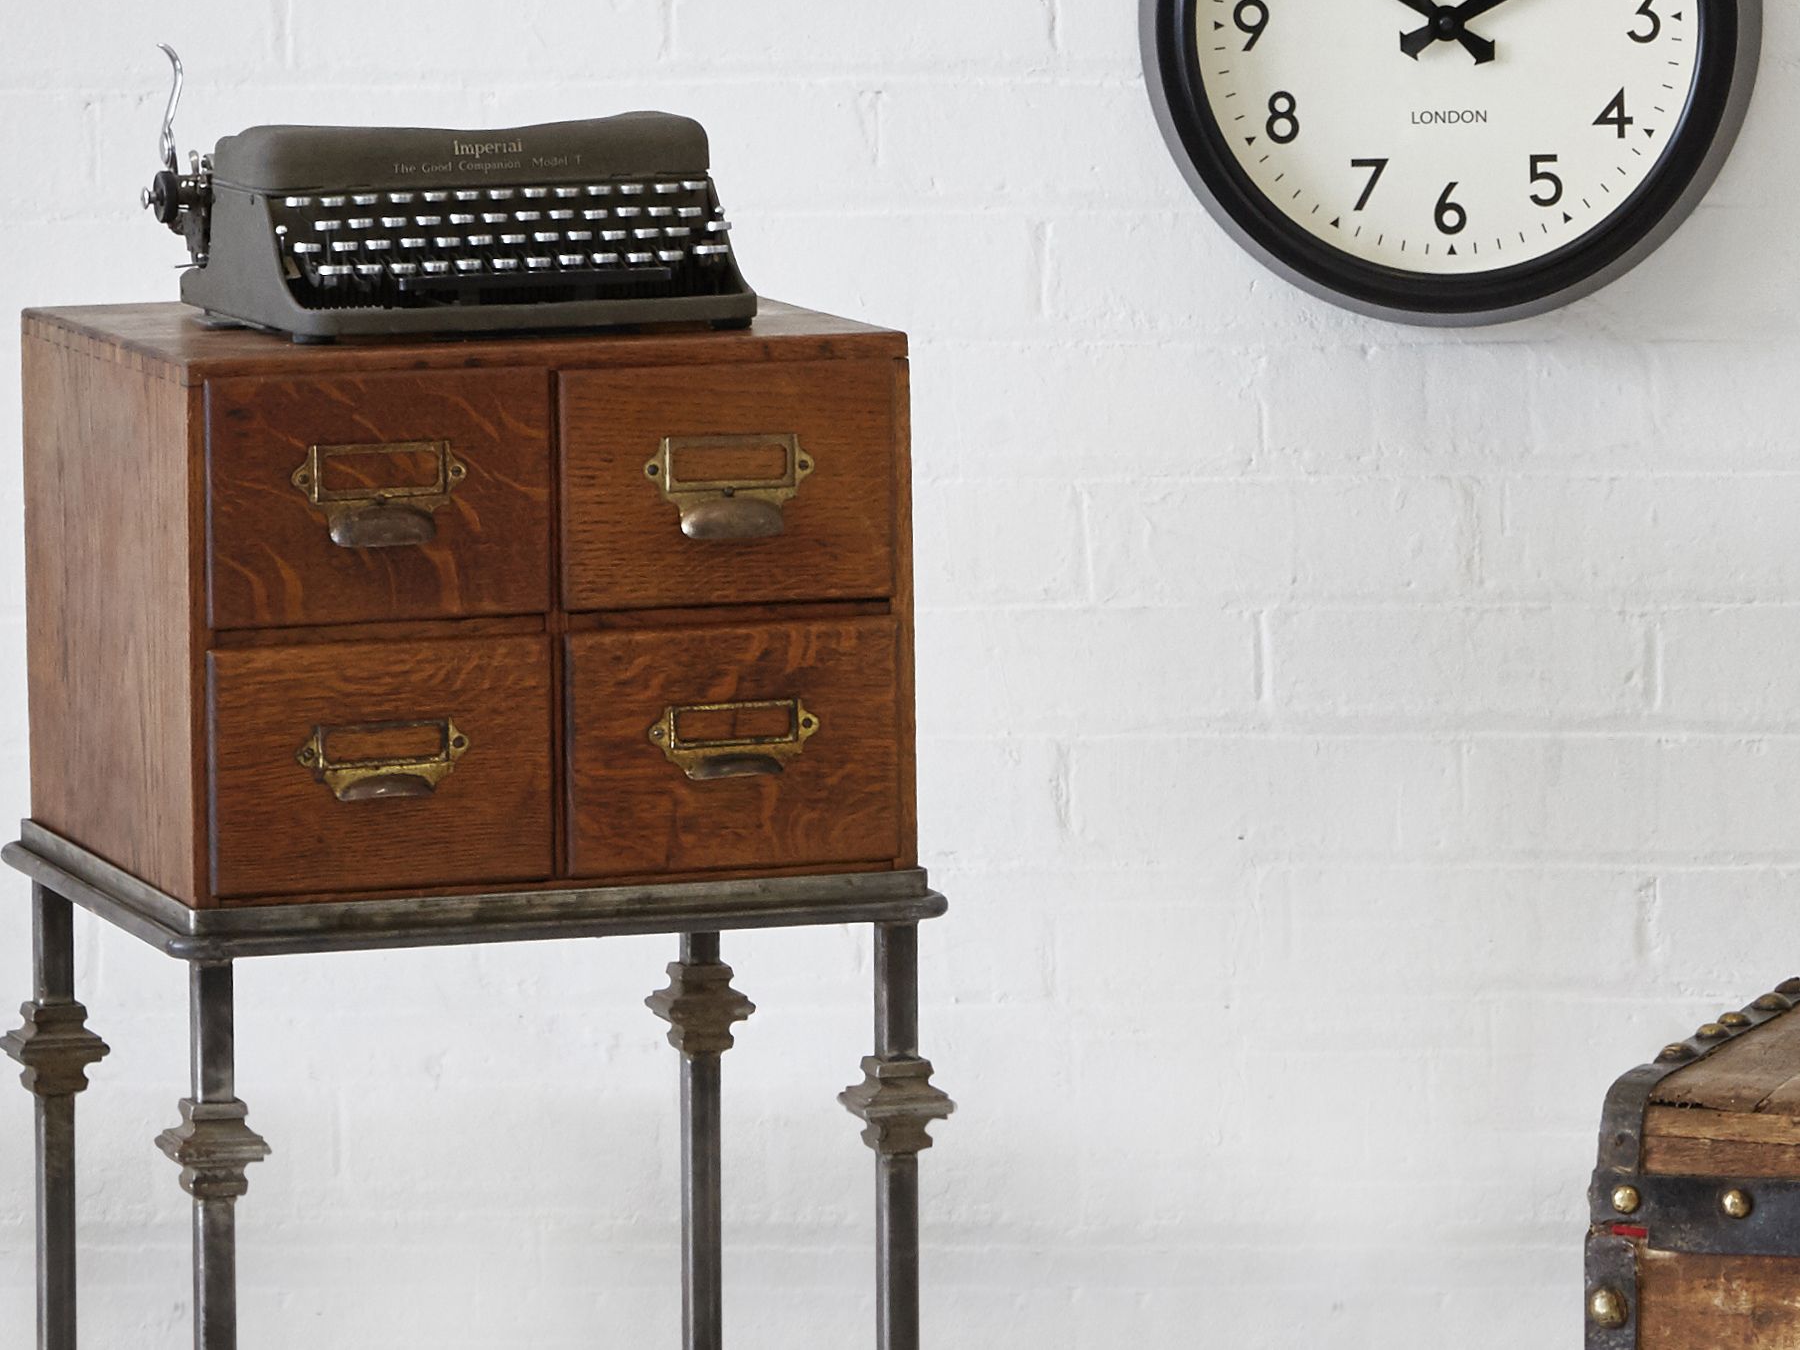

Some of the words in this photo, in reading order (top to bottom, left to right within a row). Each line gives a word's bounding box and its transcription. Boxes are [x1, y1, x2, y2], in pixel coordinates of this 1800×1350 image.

[1265, 91, 1300, 145] 8
[1411, 110, 1488, 124] LONDON
[1593, 87, 1634, 139] 4
[393, 162, 417, 175] The
[422, 161, 452, 174] Good
[458, 159, 521, 175] Companion
[532, 155, 569, 168] Model
[1350, 159, 1389, 212] 7
[1529, 153, 1563, 207] 5
[1434, 181, 1467, 236] 6
